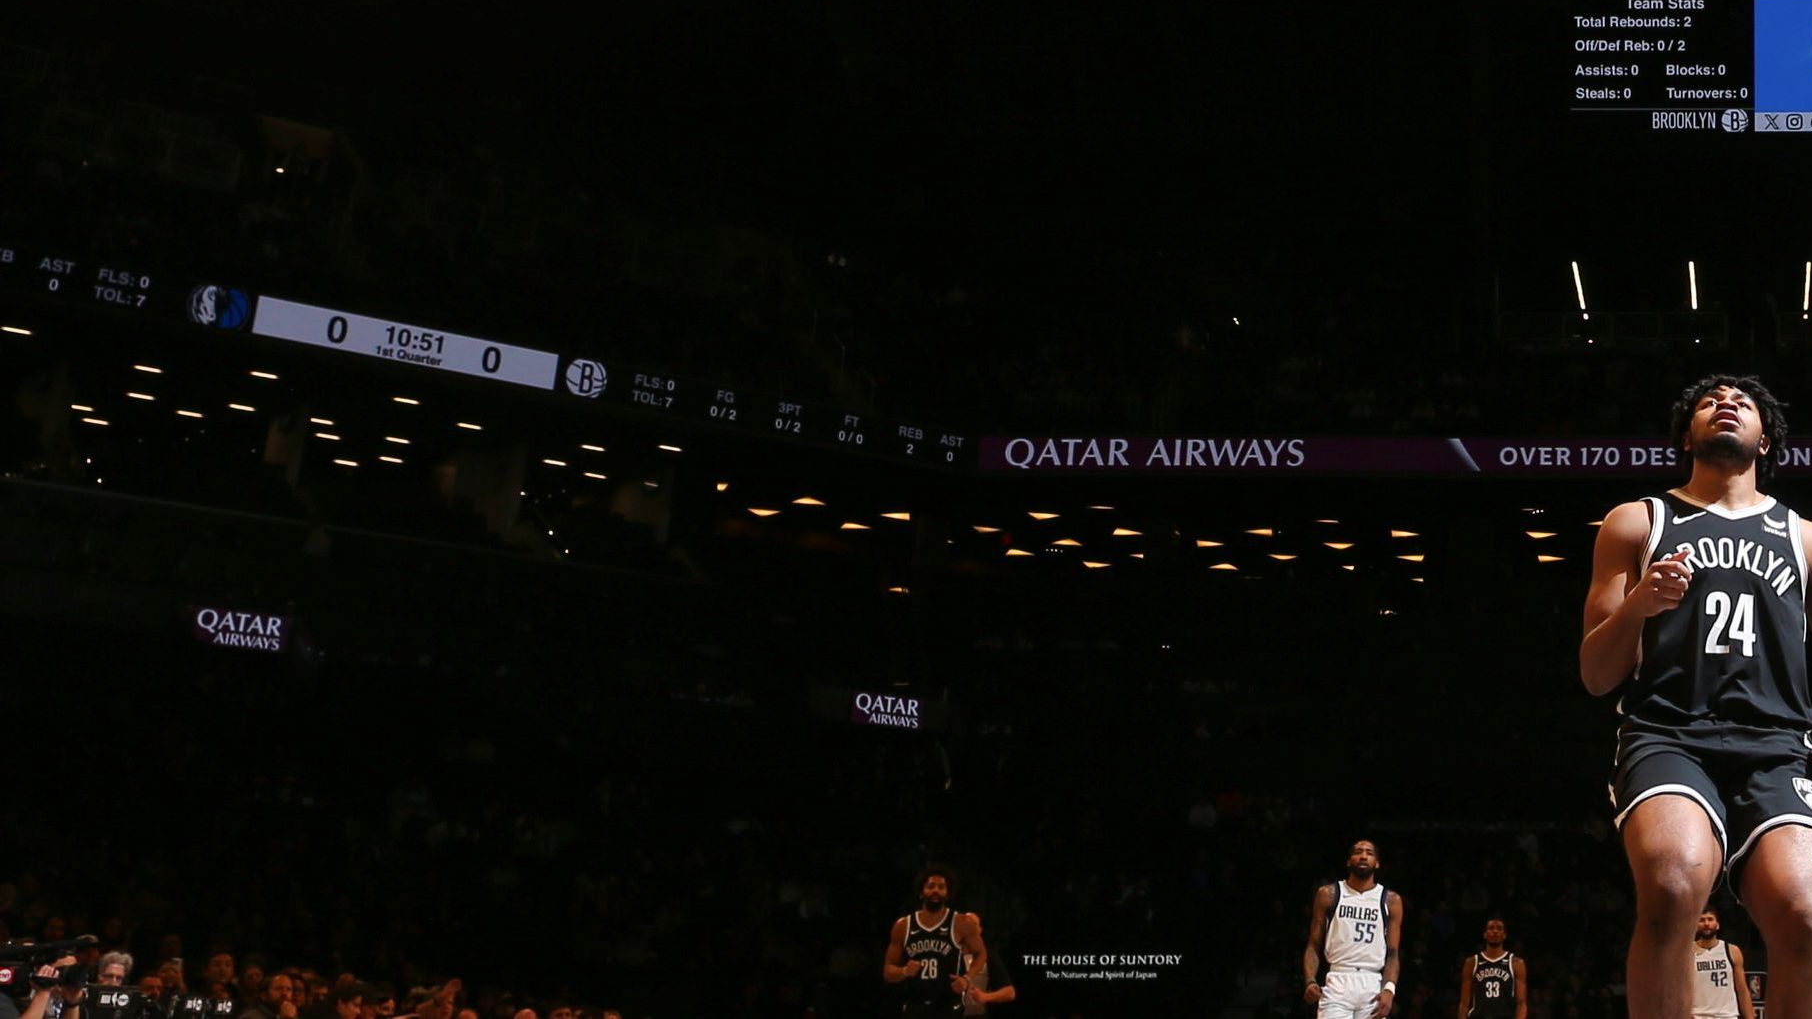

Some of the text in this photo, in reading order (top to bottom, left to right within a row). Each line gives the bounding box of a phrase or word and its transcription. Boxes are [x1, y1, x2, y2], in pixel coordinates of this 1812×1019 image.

[1574, 16, 1692, 28] Total Rebounds: 2
[1575, 40, 1620, 52] Off/Def
[1624, 40, 1654, 52] Reb:
[1657, 40, 1665, 52] 0
[1677, 40, 1686, 52] 2
[1575, 64, 1639, 76] Assists: 0
[1666, 64, 1726, 76] Blocks: 0
[1576, 88, 1631, 99] Steals: 0
[1666, 88, 1748, 99] Turnovers: 0
[1652, 112, 1716, 130] BROOKLYN
[40, 257, 76, 275] AST
[48, 278, 59, 291] 0
[98, 267, 150, 289] FLS: 0
[94, 285, 147, 307] TOL: 7
[327, 315, 348, 343] 0
[386, 326, 445, 354] 10:51
[376, 345, 442, 366] 1st Quarter
[482, 346, 501, 373] 0
[634, 374, 675, 392] FLS: 0
[632, 389, 673, 408] TOL: 7
[716, 389, 735, 404] FG
[709, 405, 718, 417] 0
[728, 409, 737, 421] 2
[778, 402, 803, 417] 3PT
[775, 418, 783, 429] 0
[793, 421, 801, 433] 2
[844, 414, 860, 428] FT
[838, 430, 846, 442] 0
[855, 433, 863, 445] 0
[898, 425, 924, 440] REB
[939, 434, 965, 448] AST
[906, 443, 914, 454] 2
[946, 451, 954, 462] 0
[1004, 438, 1305, 469] QATAR AIRWAYS
[1499, 446, 1570, 467] OVER
[1580, 446, 1620, 467] 170
[1629, 446, 1676, 467] DES
[1661, 537, 1796, 597] ROOKLYN
[197, 608, 282, 637] QATAR
[1704, 590, 1757, 657] 24
[213, 632, 281, 652] AIRWAYS
[855, 692, 919, 716] QATAR
[868, 712, 919, 729] AIRWAYS
[1339, 905, 1379, 922] DALLAS
[1354, 922, 1376, 944] 55
[906, 940, 952, 957] BROOKLYN
[1023, 954, 1183, 966] THE HOUSE OF SUNTORY
[1696, 959, 1727, 972] DALLAS
[1710, 971, 1728, 987] 42
[1485, 981, 1500, 998] 33
